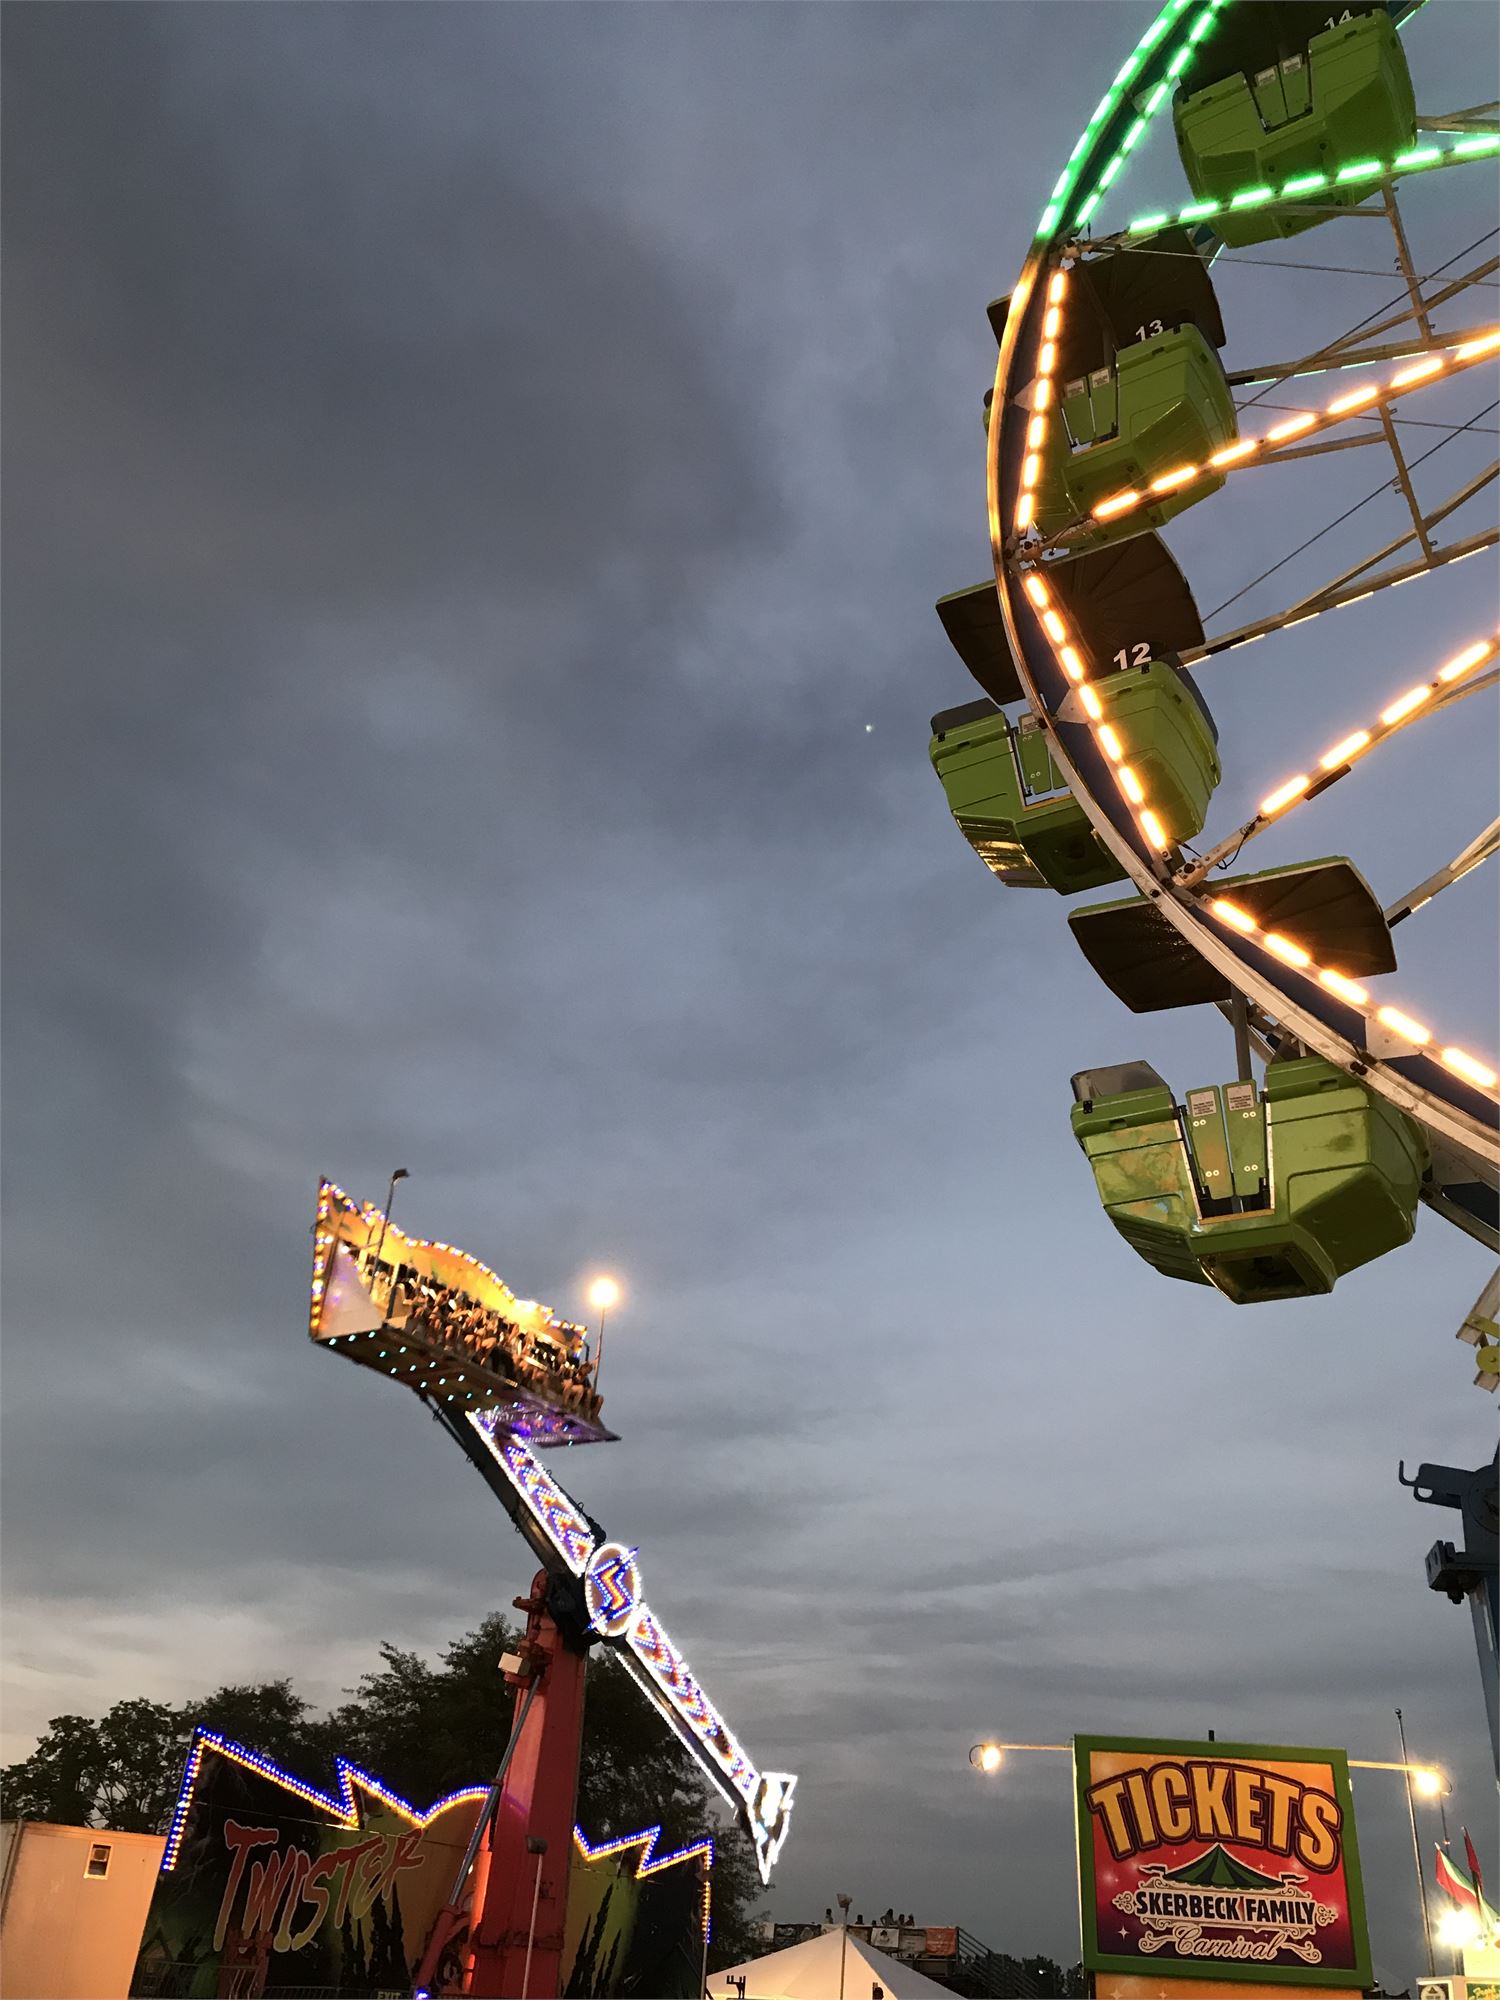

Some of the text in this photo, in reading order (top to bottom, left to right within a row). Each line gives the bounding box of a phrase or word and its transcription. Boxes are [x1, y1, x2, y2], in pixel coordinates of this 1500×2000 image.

[1324, 9, 1353, 29] 14
[1135, 319, 1163, 341] 13
[1113, 642, 1152, 670] 12
[1087, 1761, 1342, 1873] TICKETS
[213, 1818, 425, 1952] TWISTER
[1136, 1891, 1316, 1925] SKERBECK FAMILY
[1174, 1926, 1287, 1960] Carnival
[376, 1991, 401, 2000] EXIT
